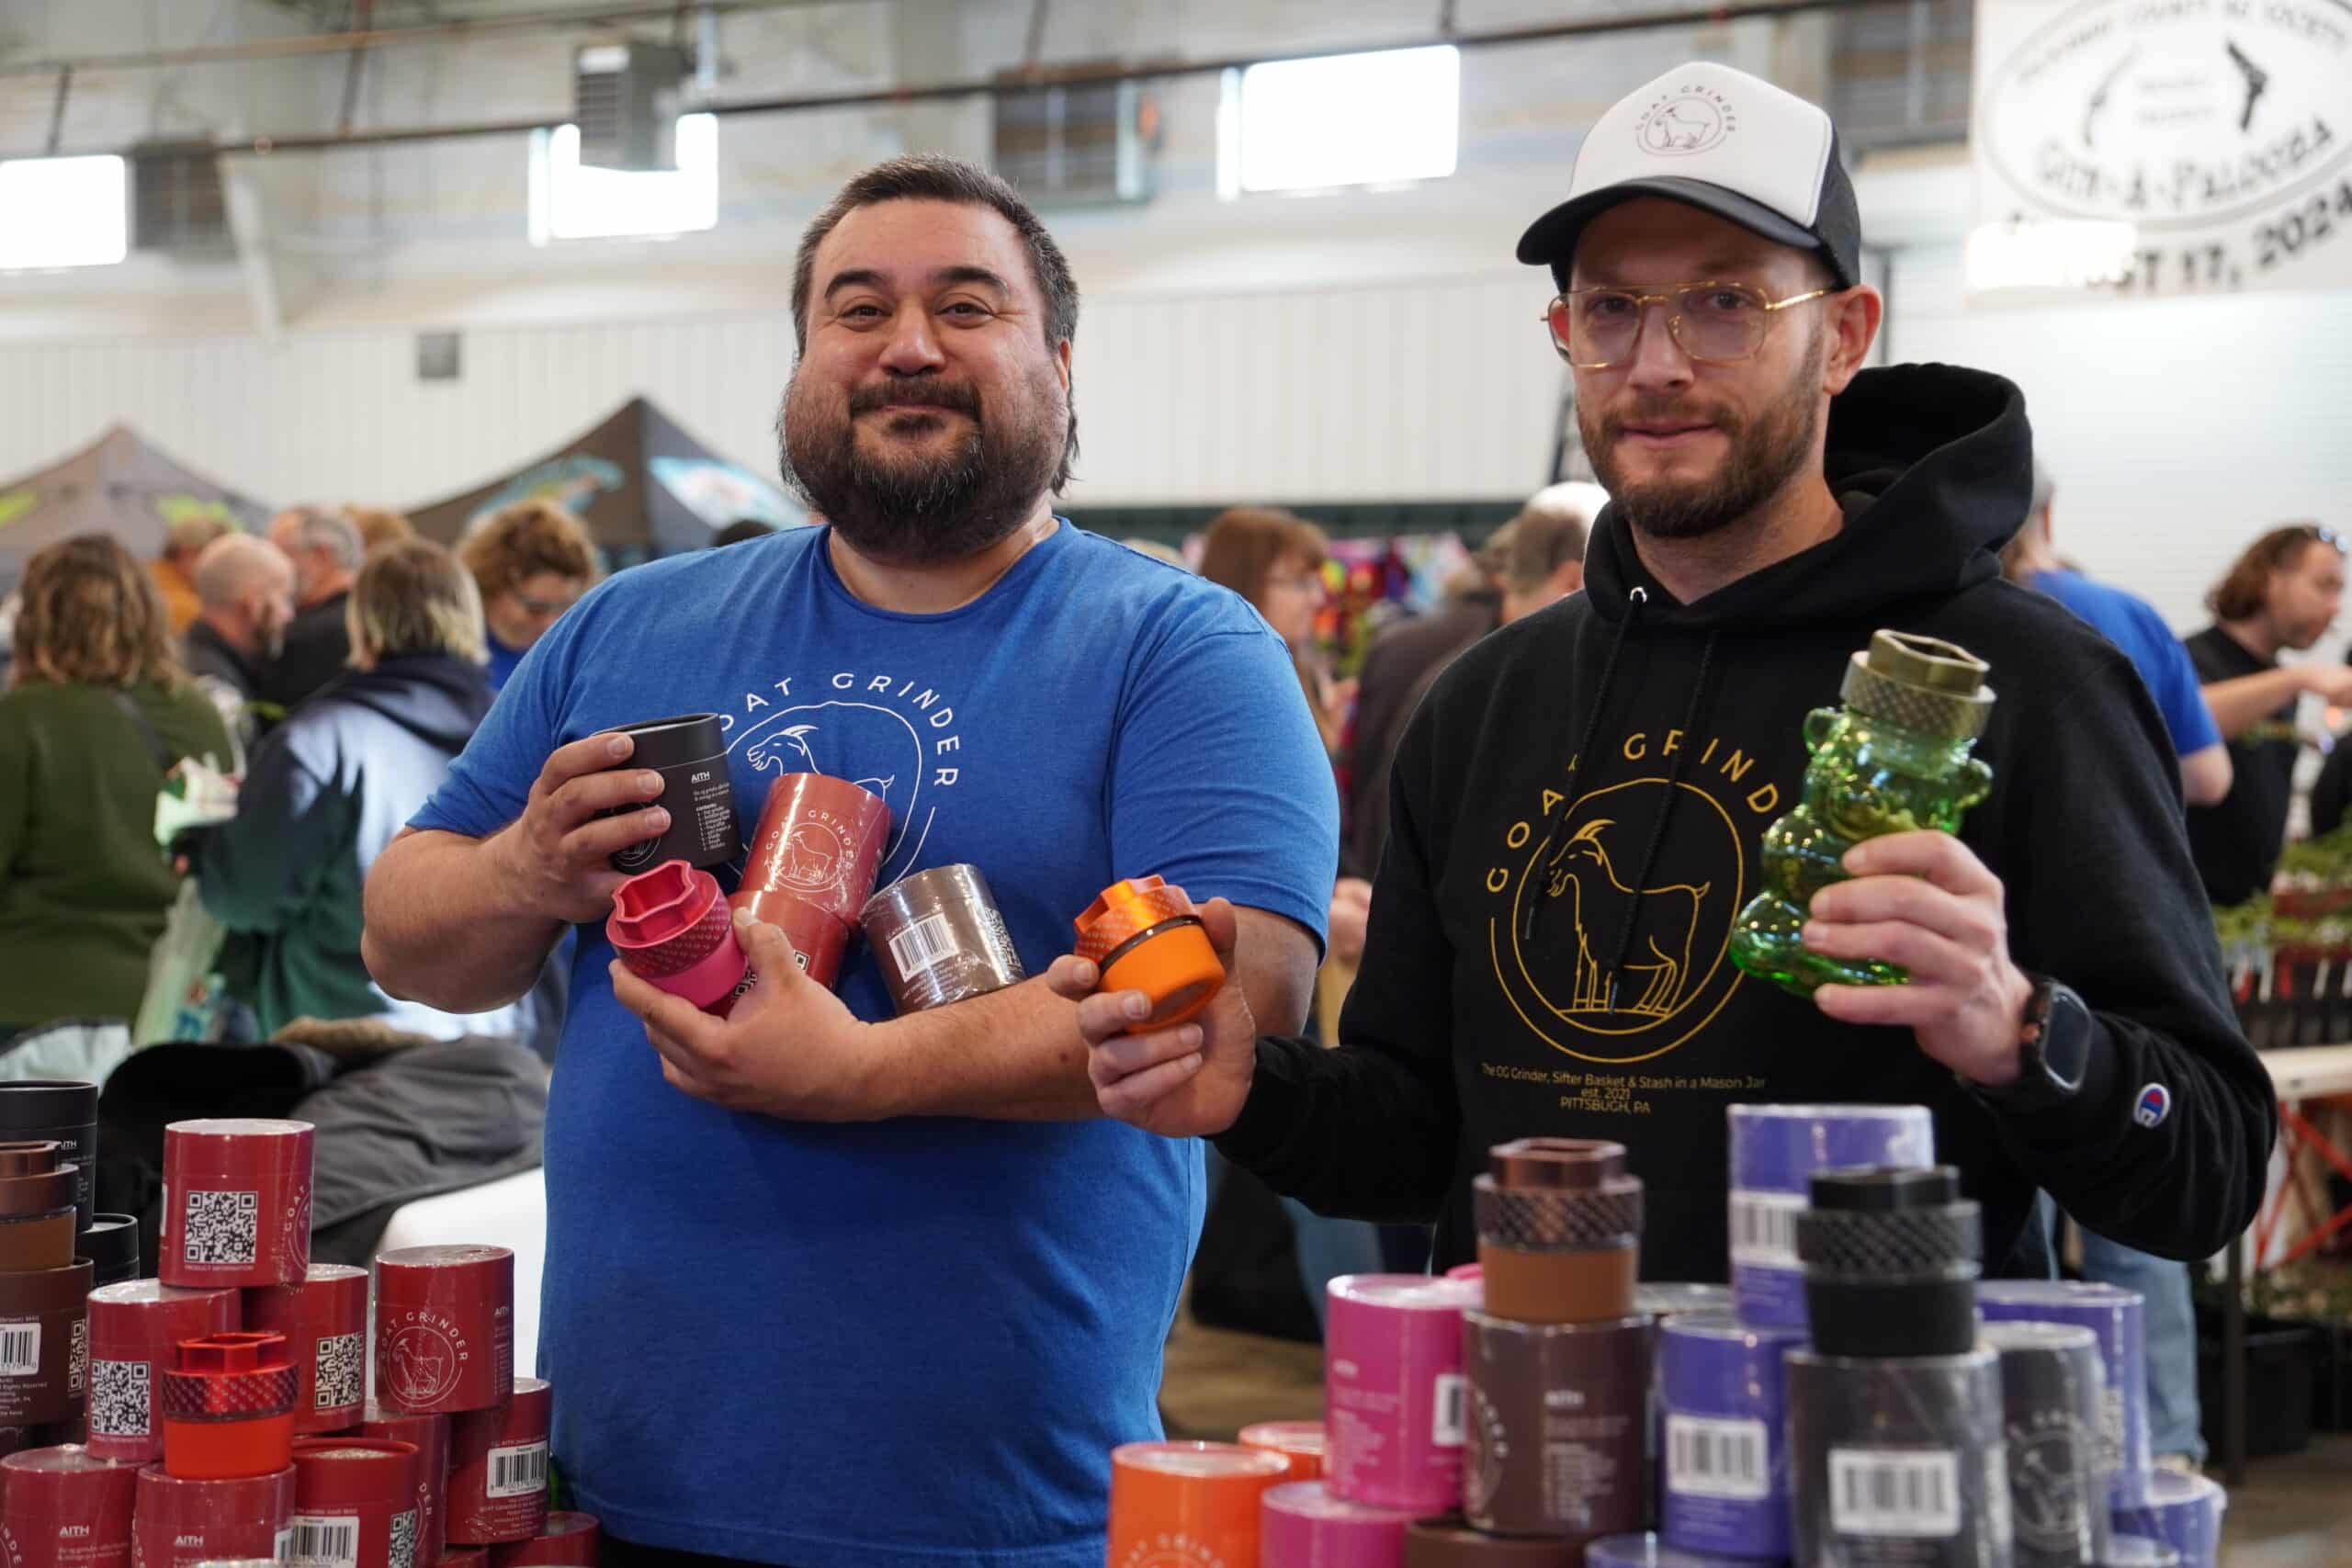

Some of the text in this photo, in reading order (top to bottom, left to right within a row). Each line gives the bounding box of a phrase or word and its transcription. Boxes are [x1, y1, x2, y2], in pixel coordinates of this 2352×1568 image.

[720, 672, 960, 787] OAT GRINDER
[691, 772, 711, 784] AITH
[1623, 729, 1780, 814] GRIND
[1552, 1071, 1581, 1085] Sifter
[1585, 1073, 1625, 1087] Basket
[1627, 1076, 1636, 1088] &
[1639, 1076, 1673, 1089] Stash
[1675, 1076, 1687, 1088] in
[1690, 1078, 1698, 1089] a
[1700, 1077, 1743, 1089] Mason
[1746, 1076, 1765, 1089] Jar
[1581, 1088, 1631, 1100] est. 2021
[1634, 1100, 1651, 1114] PA
[405, 1311, 469, 1360] GRINDER
[59, 1525, 90, 1538] AITH
[175, 1535, 203, 1548] AITH
